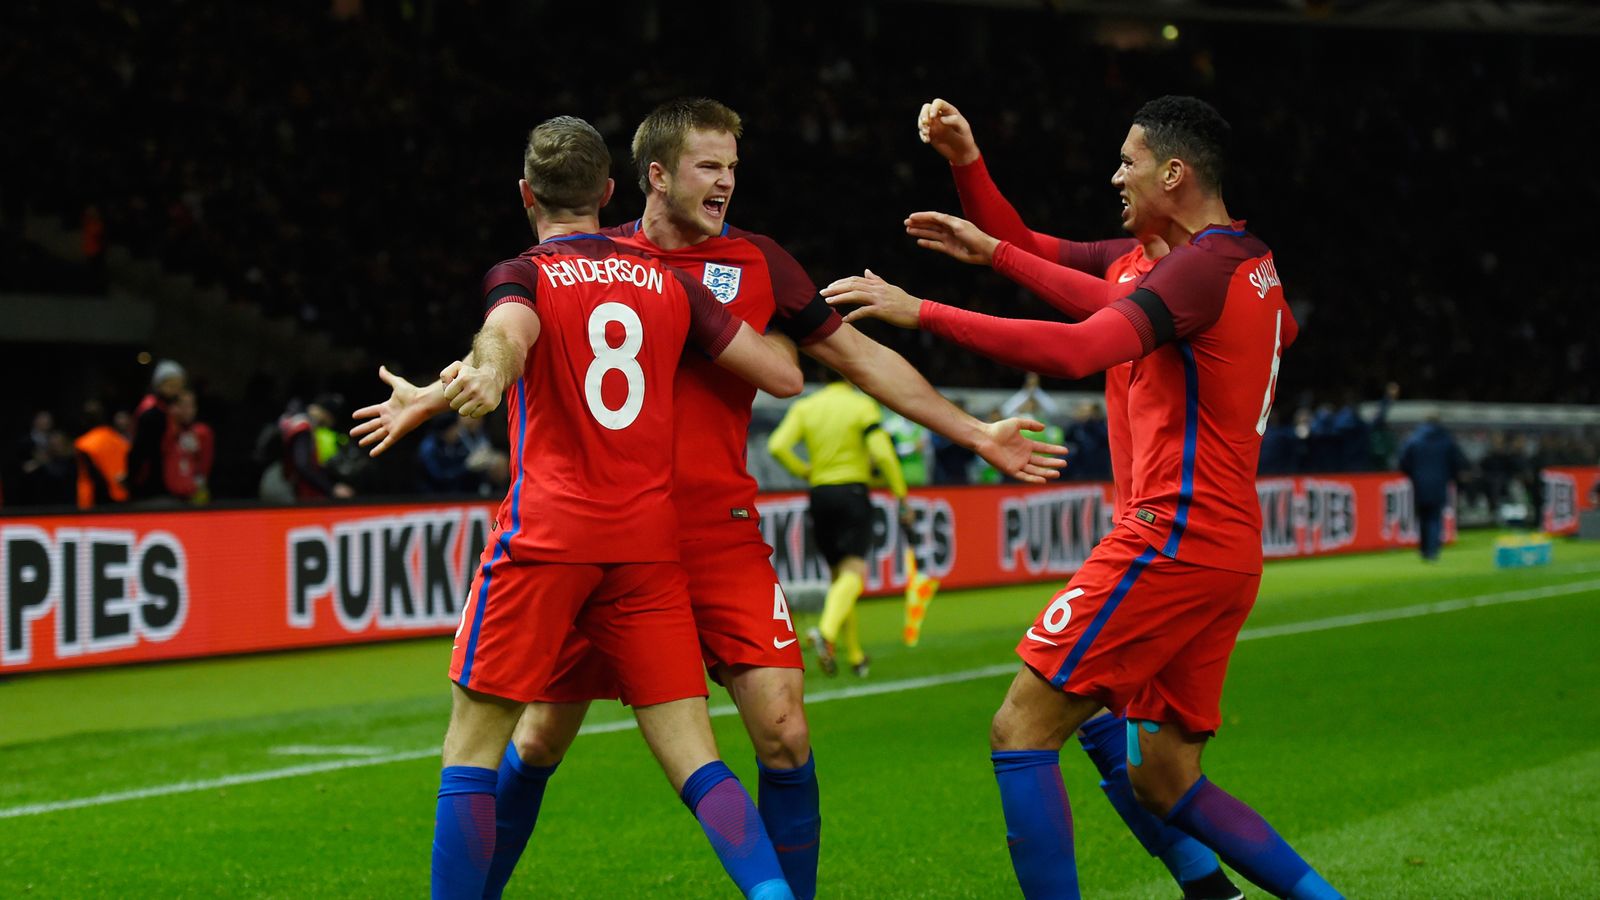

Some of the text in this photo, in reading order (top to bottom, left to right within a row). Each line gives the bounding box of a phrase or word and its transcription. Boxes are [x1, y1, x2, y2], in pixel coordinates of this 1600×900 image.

[541, 258, 663, 295] HENDERSON
[584, 302, 645, 430] 8
[1, 525, 188, 665] PIES
[773, 583, 793, 632] 4
[1043, 588, 1085, 633] 6
